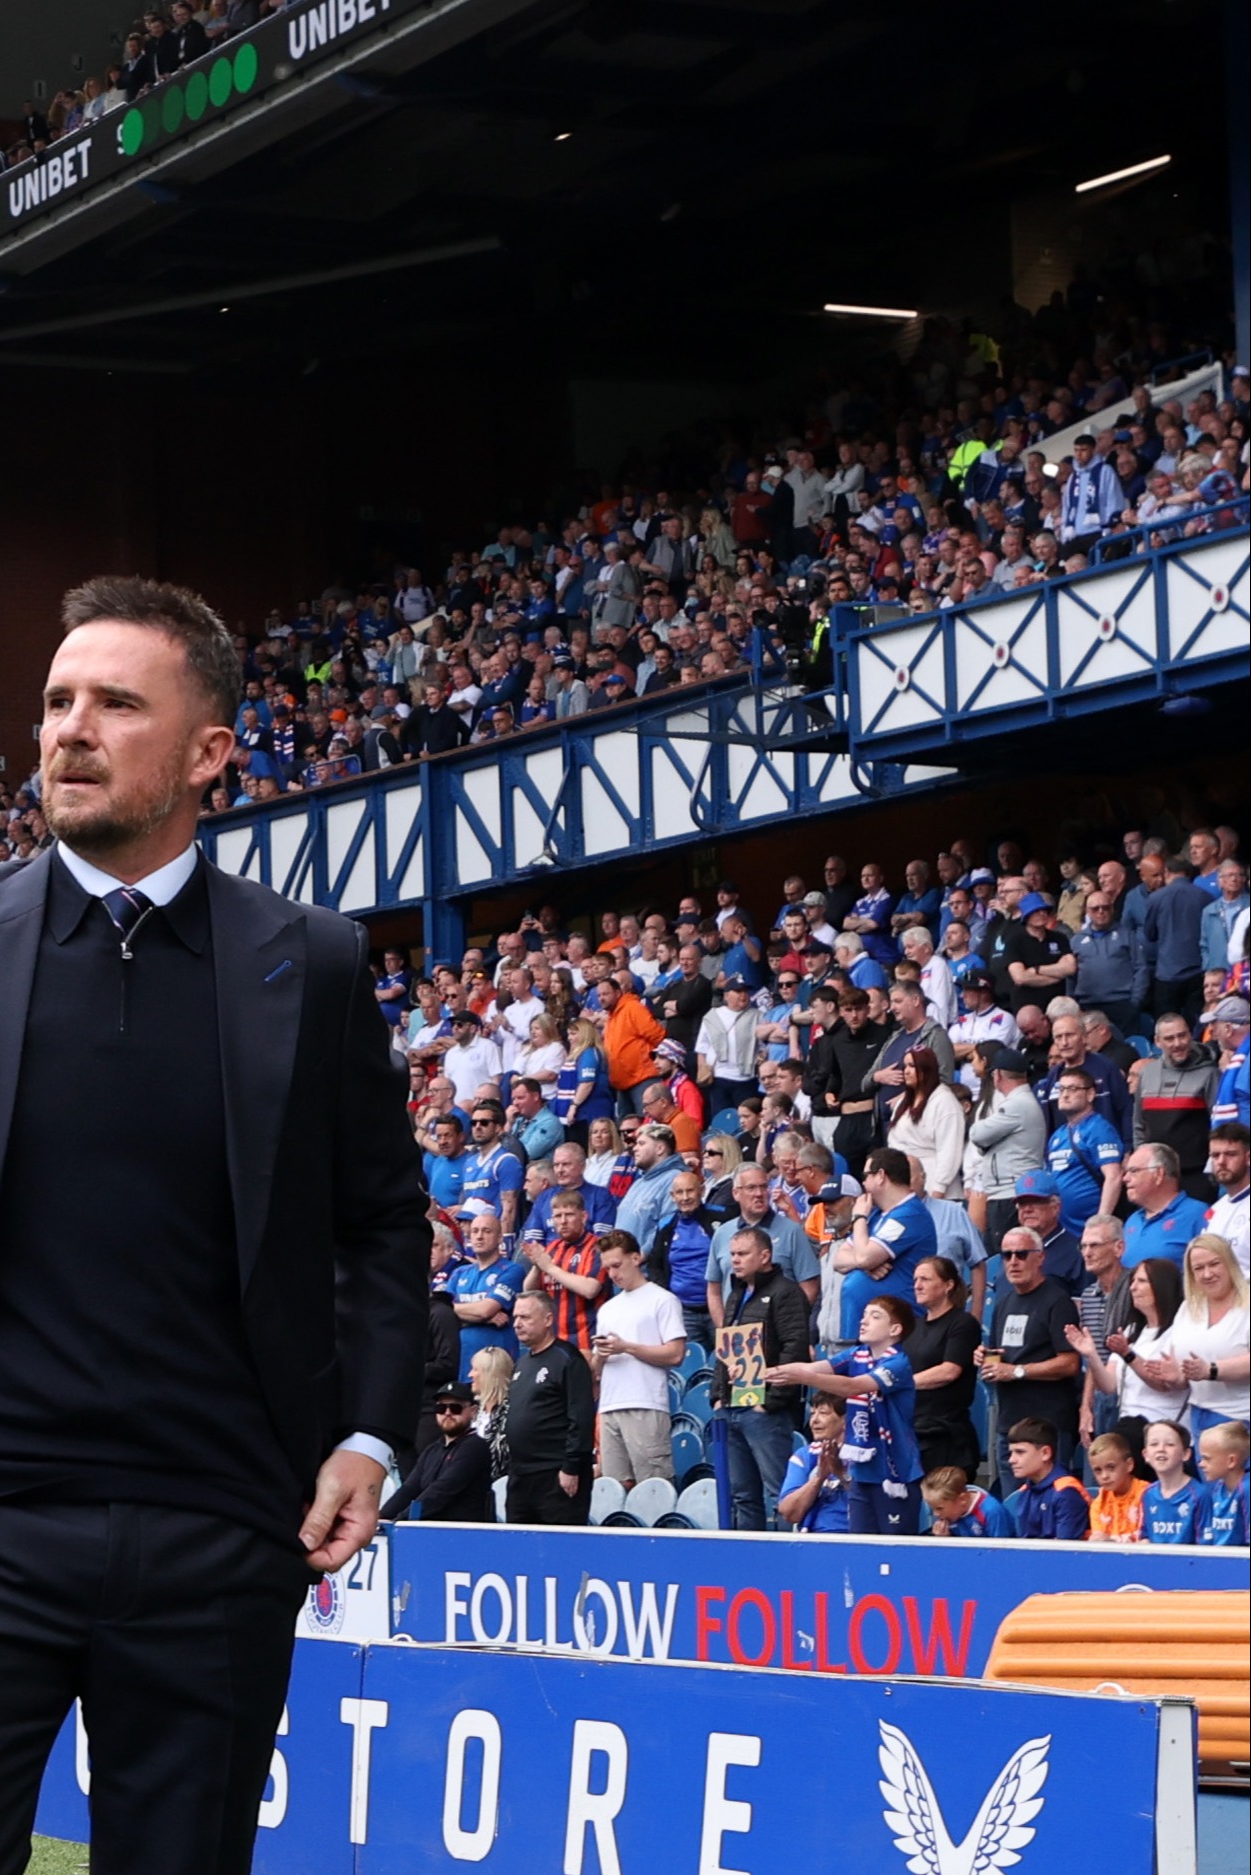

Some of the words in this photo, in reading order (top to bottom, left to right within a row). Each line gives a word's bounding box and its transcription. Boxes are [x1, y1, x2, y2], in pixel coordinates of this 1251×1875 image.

[9, 137, 92, 217] UNIBET
[734, 1355, 763, 1388] 22
[444, 1571, 679, 1660] FOLLOW
[695, 1585, 977, 1677] FOLLOW
[75, 1696, 762, 1875] TORE
